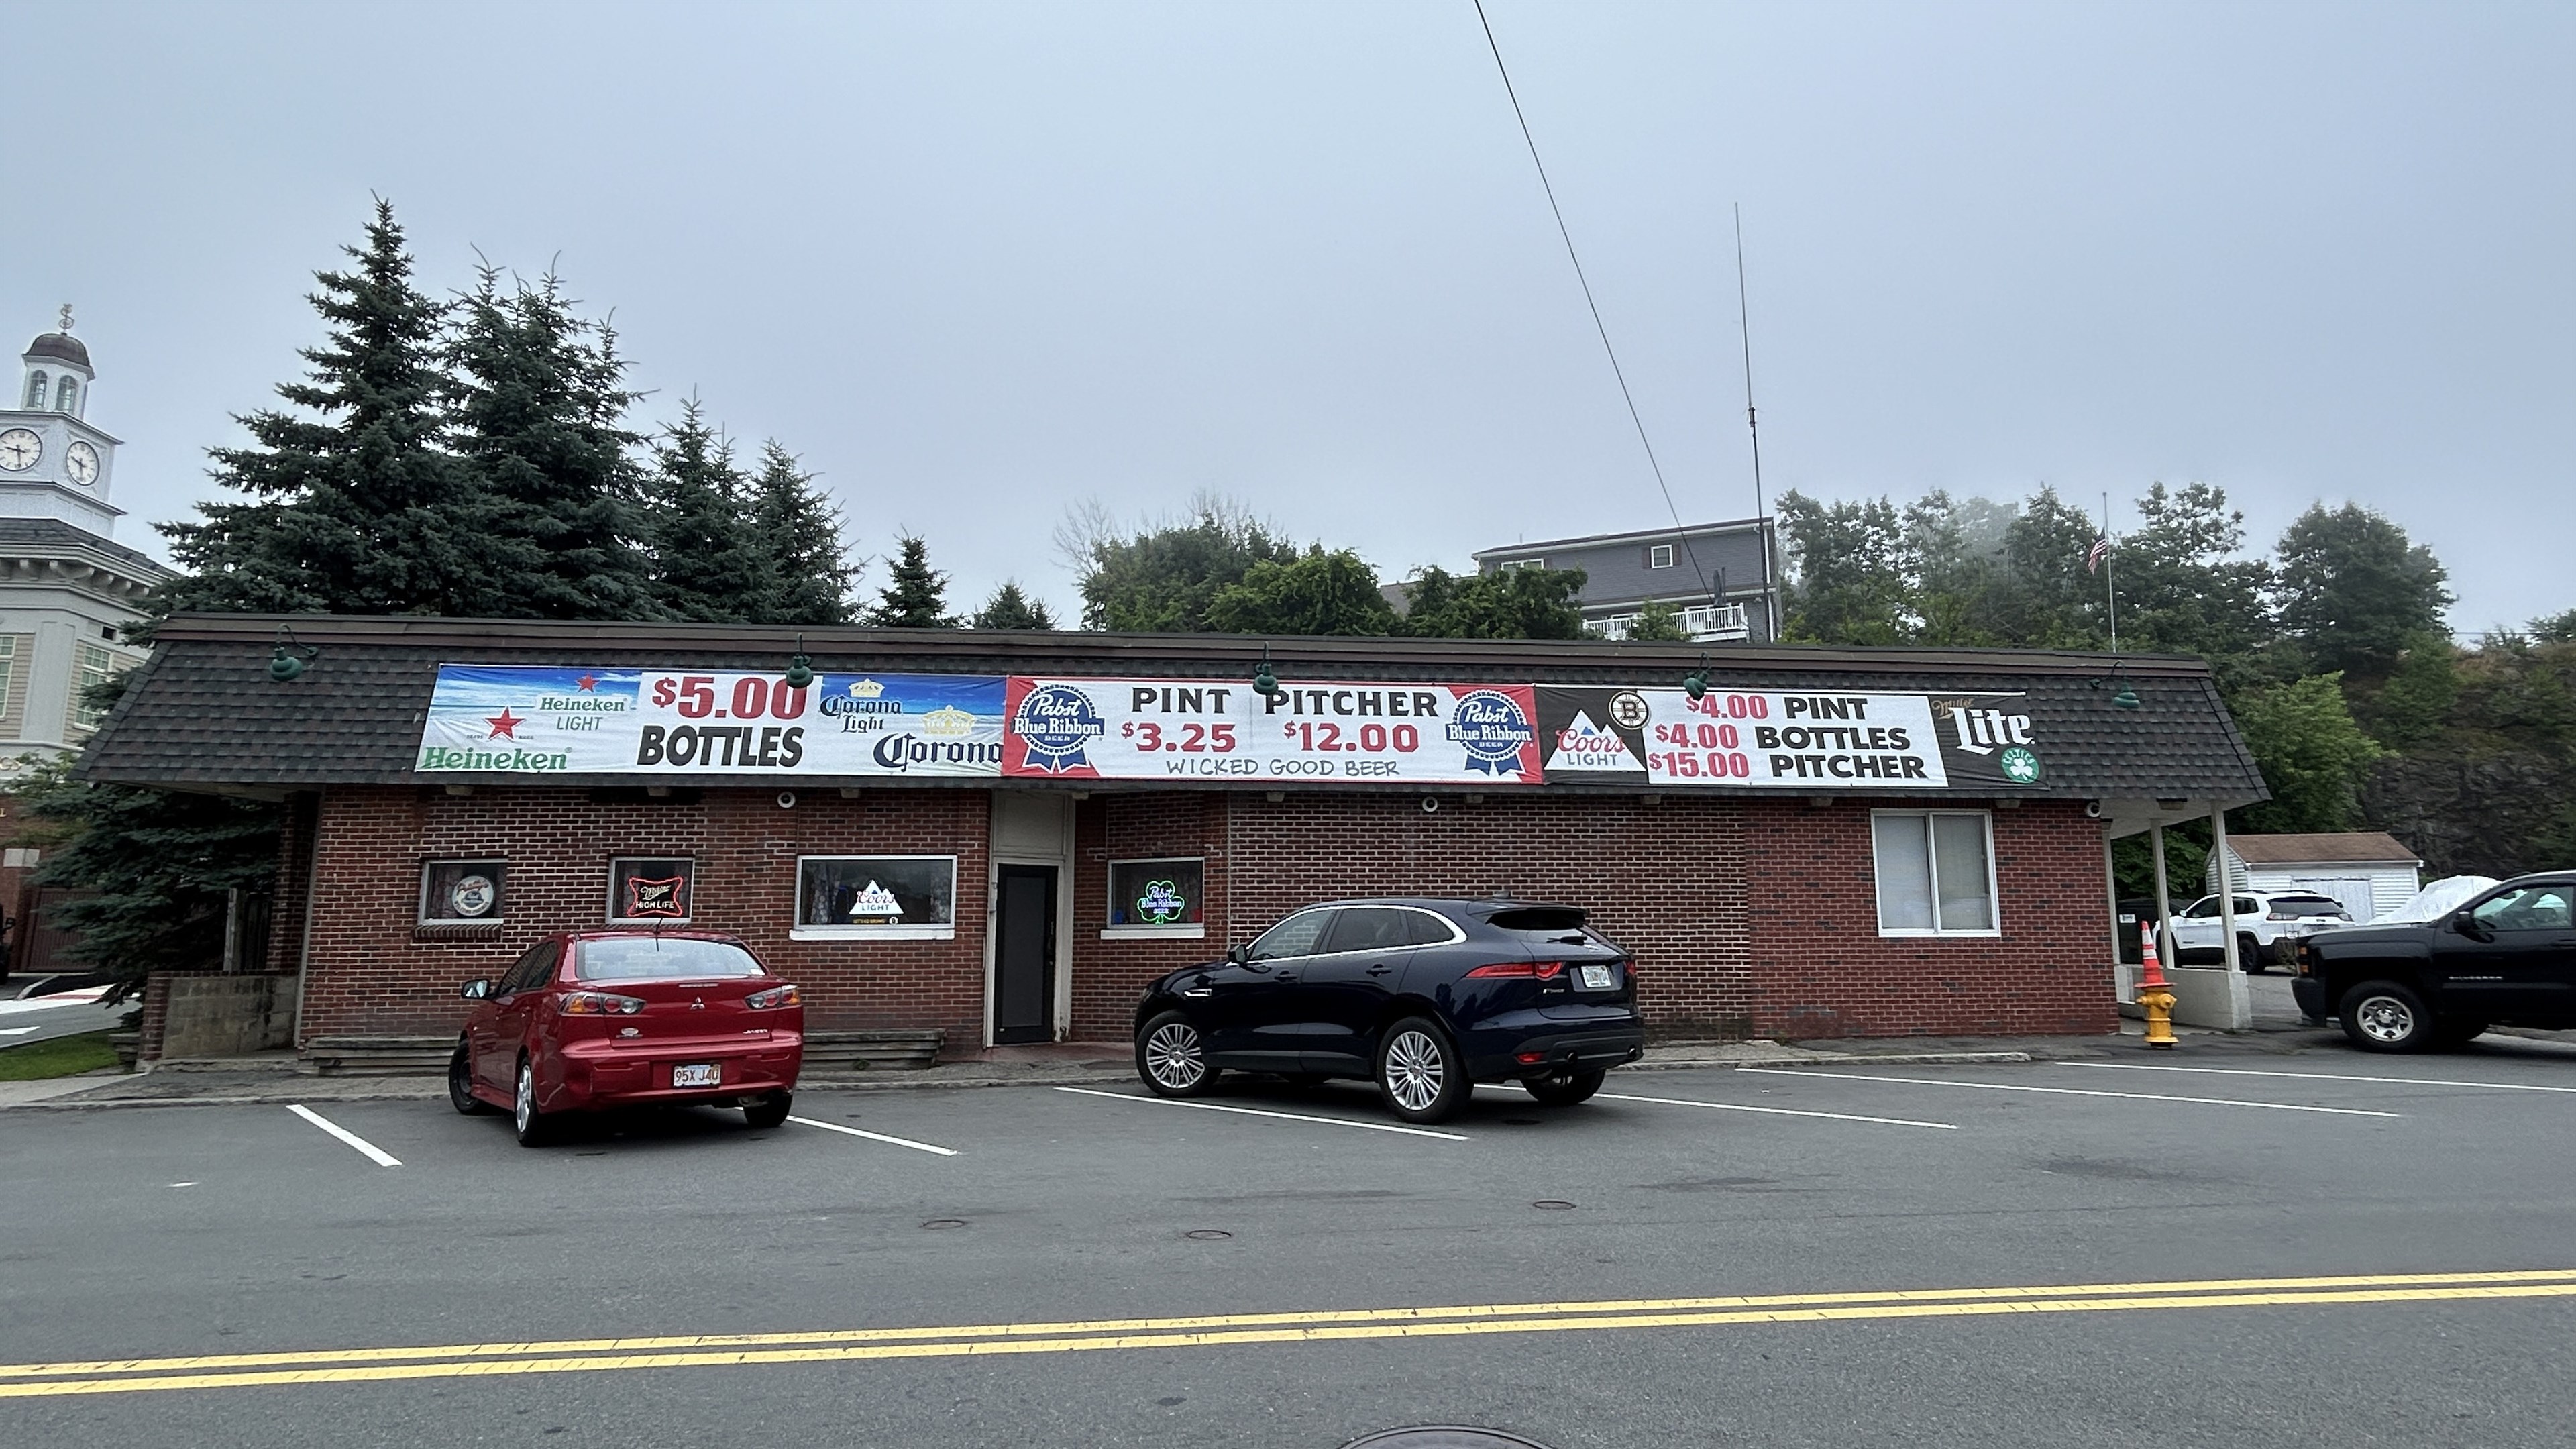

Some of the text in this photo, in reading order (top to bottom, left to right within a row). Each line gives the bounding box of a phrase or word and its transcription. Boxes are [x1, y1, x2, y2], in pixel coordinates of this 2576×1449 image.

[539, 697, 625, 712] Heineken
[652, 676, 808, 720] $5.00
[820, 695, 902, 719] Corona
[1033, 694, 1082, 716] Pabst
[1132, 687, 1439, 717] PINT PITCHER
[1685, 694, 1868, 720] $4.00 PINT
[1931, 698, 1976, 720] Miller
[1463, 700, 1509, 722] Pabst
[1621, 700, 1639, 719] B
[556, 716, 603, 731] LIGHT
[841, 714, 884, 733] Light
[1014, 717, 1102, 735] Blue Ribbon
[1448, 724, 1532, 741] Blue Ribbon
[637, 724, 805, 767] BOTTLES
[1121, 720, 1419, 752] $3.25 $12.00
[1555, 729, 1625, 753] Coors
[1655, 723, 1911, 750] $4.00 BOTTLES
[421, 747, 566, 771] Heineken
[873, 733, 1004, 772] Corona
[1567, 753, 1617, 766] LIGHT
[2002, 748, 2036, 765] CELTICS
[1166, 758, 1400, 776] WICKED GOOD BEER
[1648, 752, 1929, 778] $15.00 PITCHER
[657, 900, 675, 908] LIFE
[857, 891, 894, 903] Coors
[676, 1069, 696, 1082] 95X
